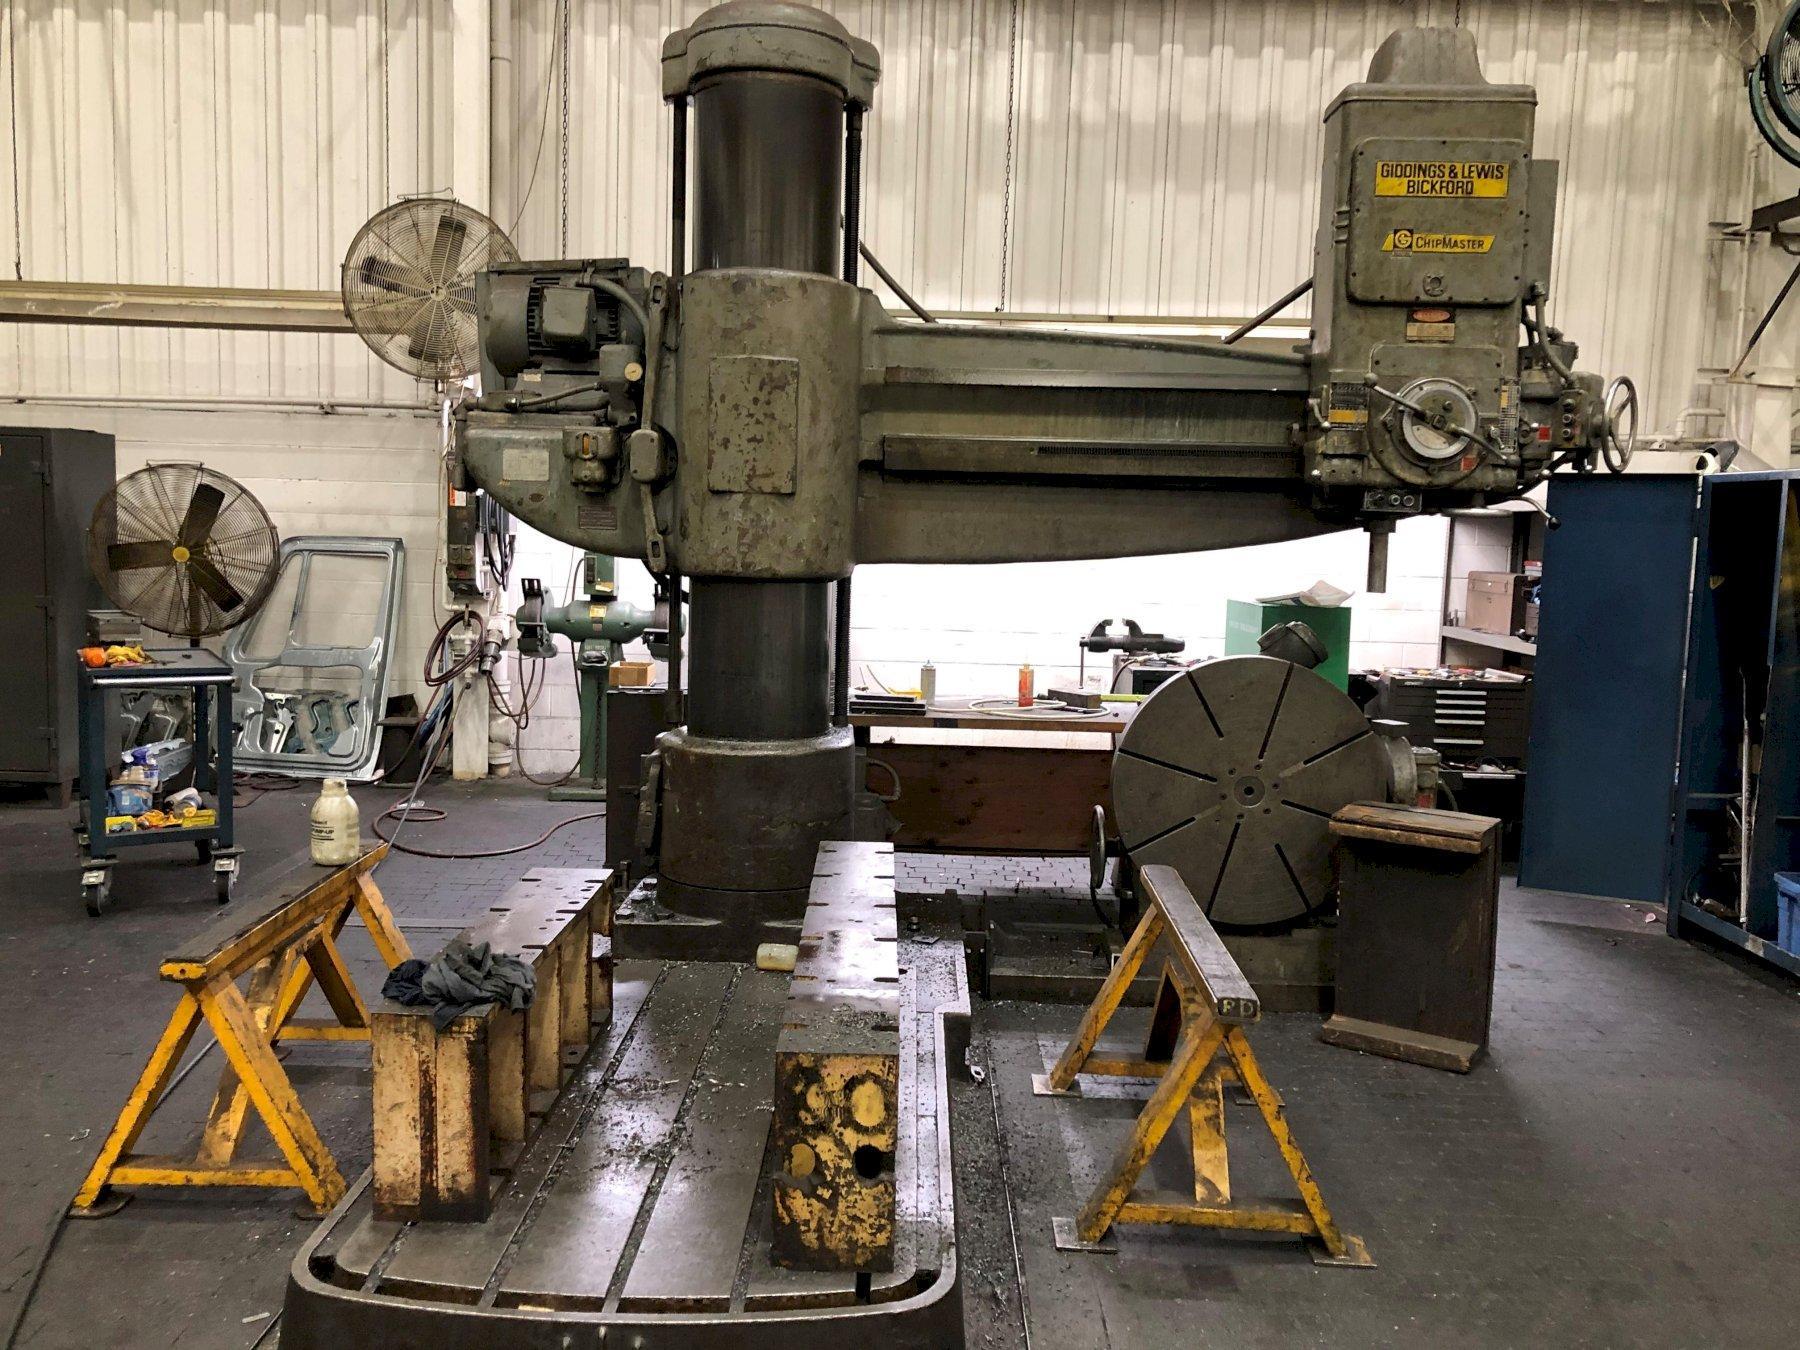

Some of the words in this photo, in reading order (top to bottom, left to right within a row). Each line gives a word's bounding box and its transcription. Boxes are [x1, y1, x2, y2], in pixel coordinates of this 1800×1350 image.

[1381, 163, 1446, 178] GIDDINGS
[1449, 164, 1458, 178] &
[1461, 165, 1504, 179] LEWIS
[1406, 180, 1474, 195] BICKFORD
